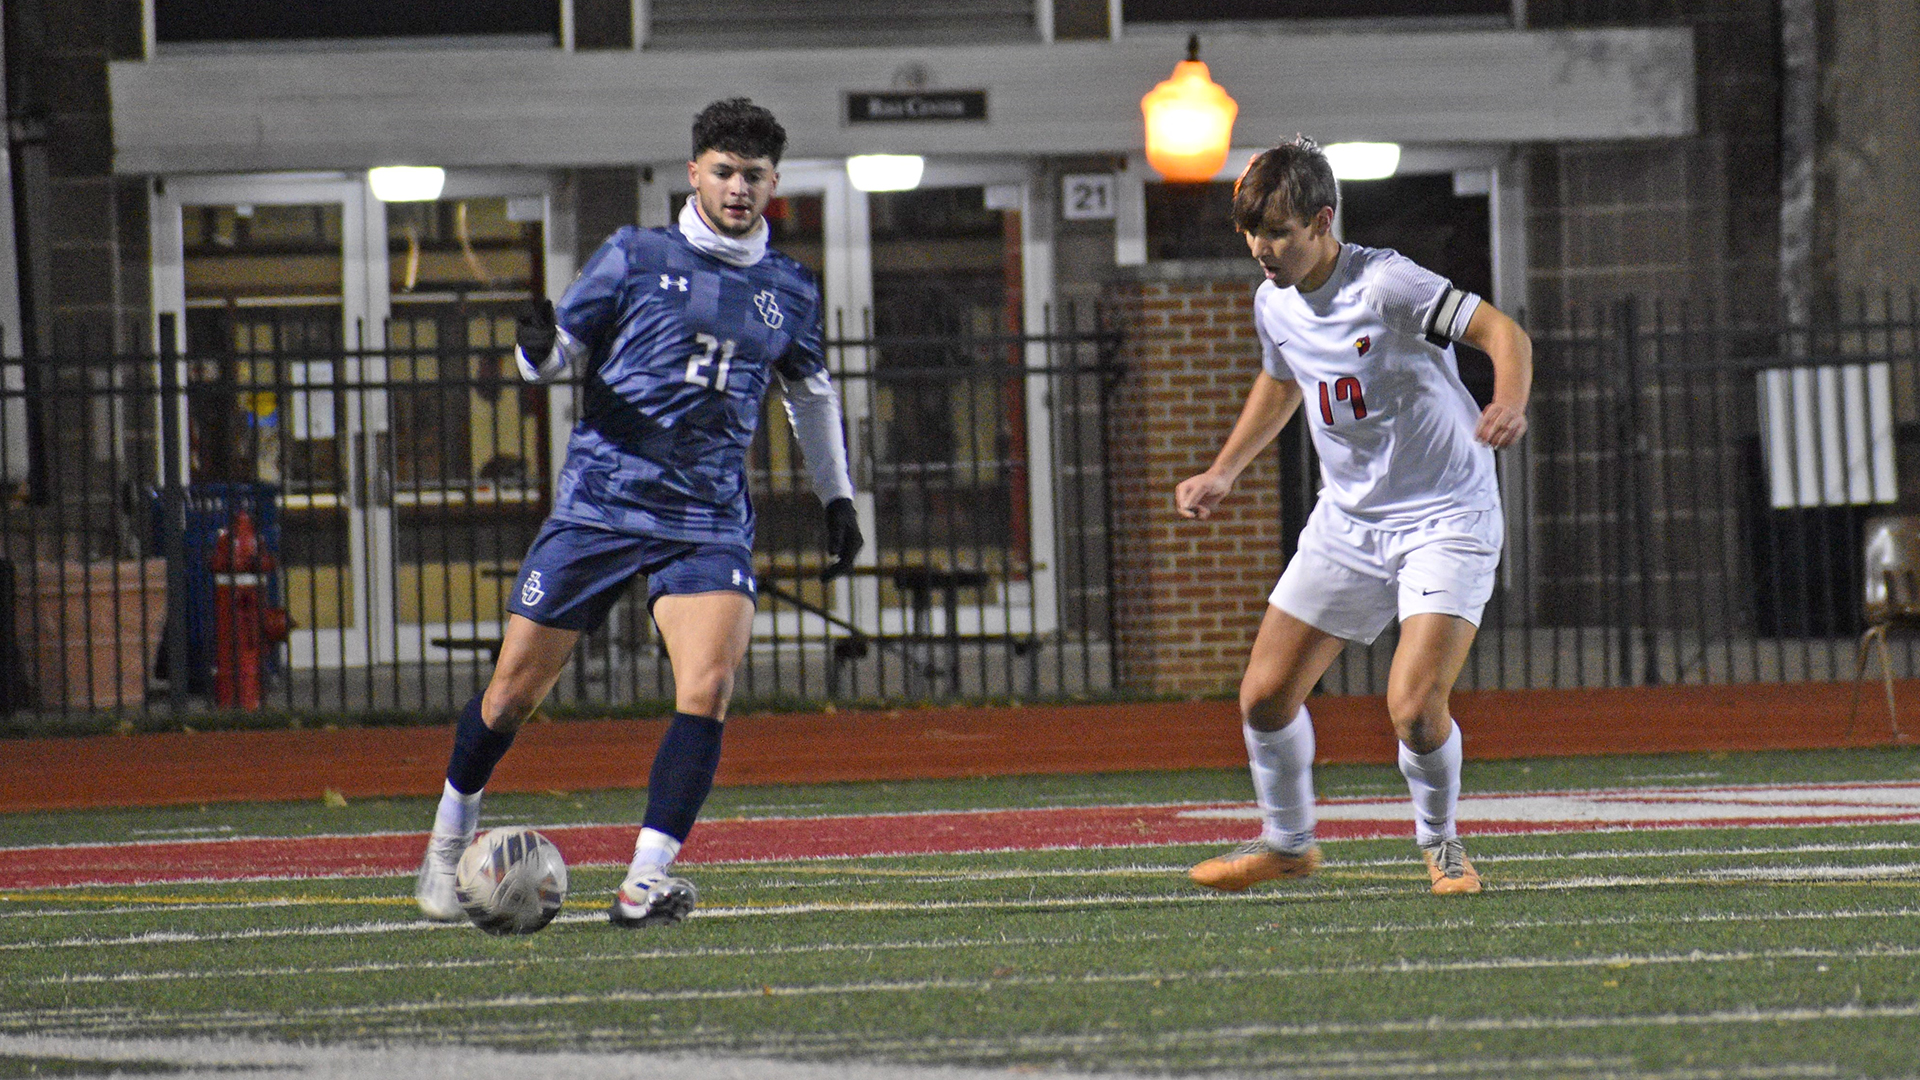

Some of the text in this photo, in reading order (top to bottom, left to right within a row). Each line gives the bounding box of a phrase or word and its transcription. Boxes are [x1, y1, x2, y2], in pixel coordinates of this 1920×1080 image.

[1073, 184, 1107, 210] 21
[684, 332, 736, 392] 21
[1318, 376, 1368, 426] 17
